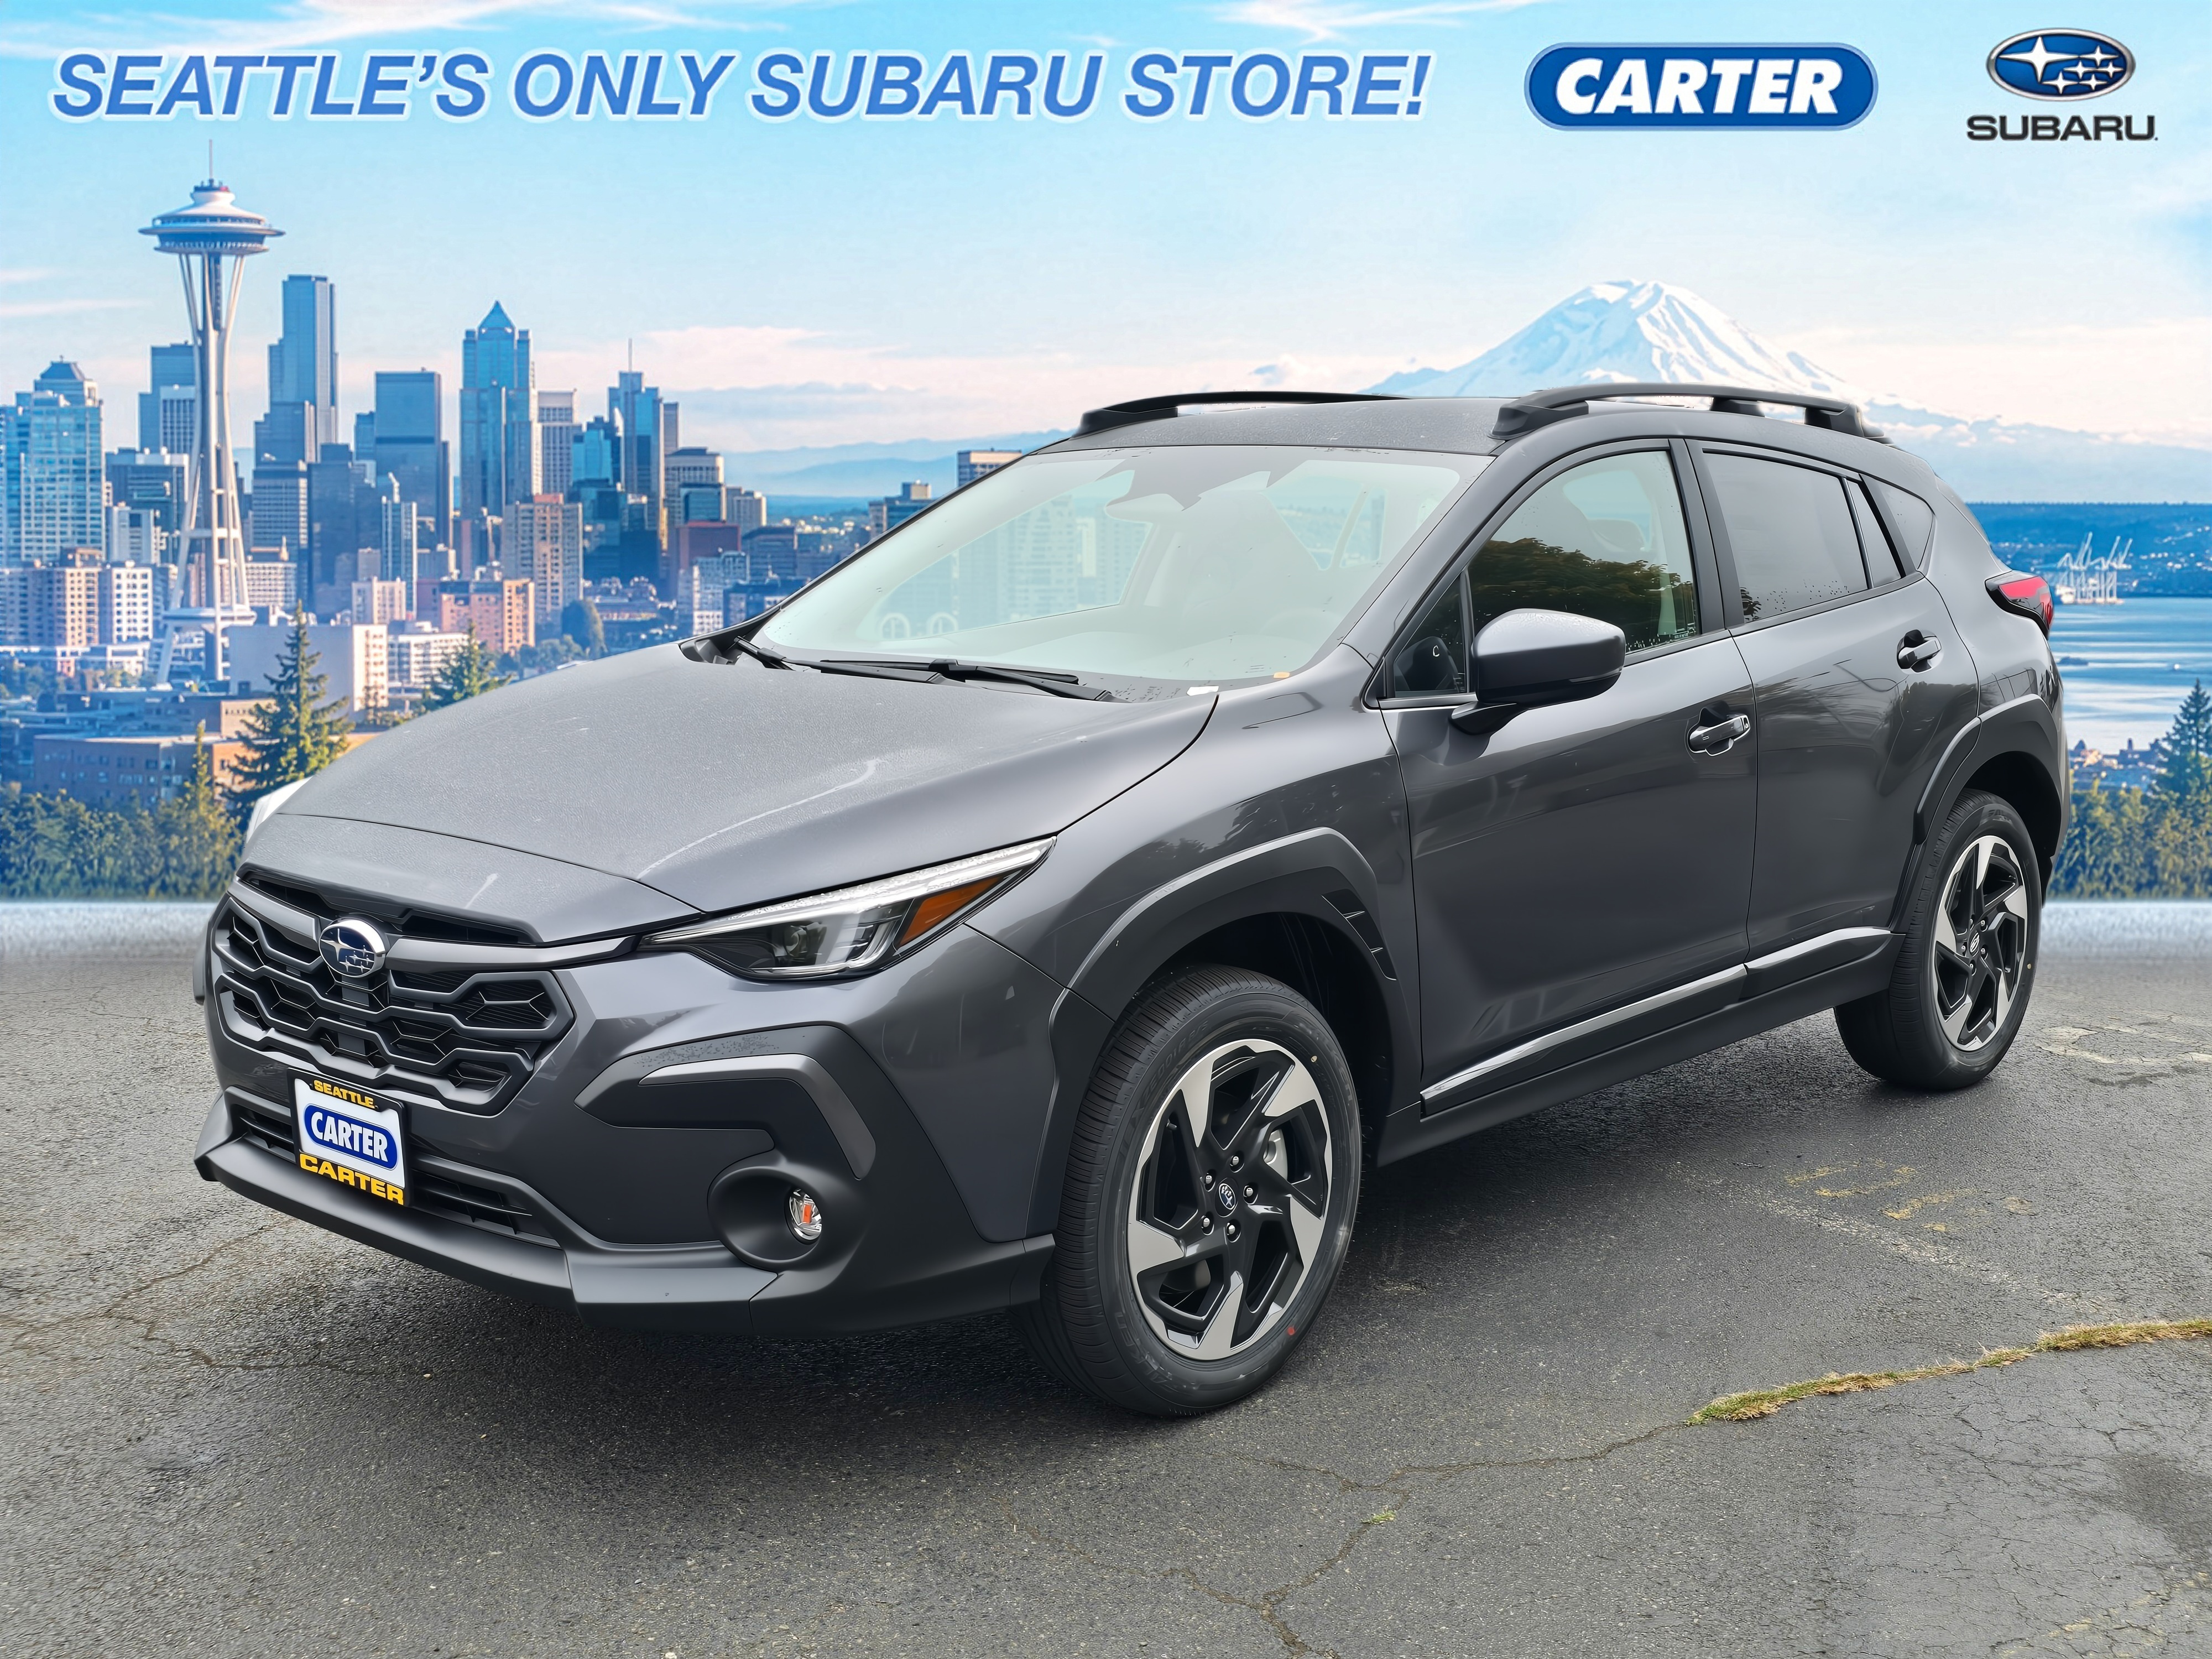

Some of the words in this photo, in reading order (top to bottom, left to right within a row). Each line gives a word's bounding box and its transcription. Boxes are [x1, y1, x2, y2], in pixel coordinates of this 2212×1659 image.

[313, 1079, 375, 1109] SEATTLE
[310, 1112, 388, 1162] CARTER
[299, 1153, 404, 1206] CARTER
